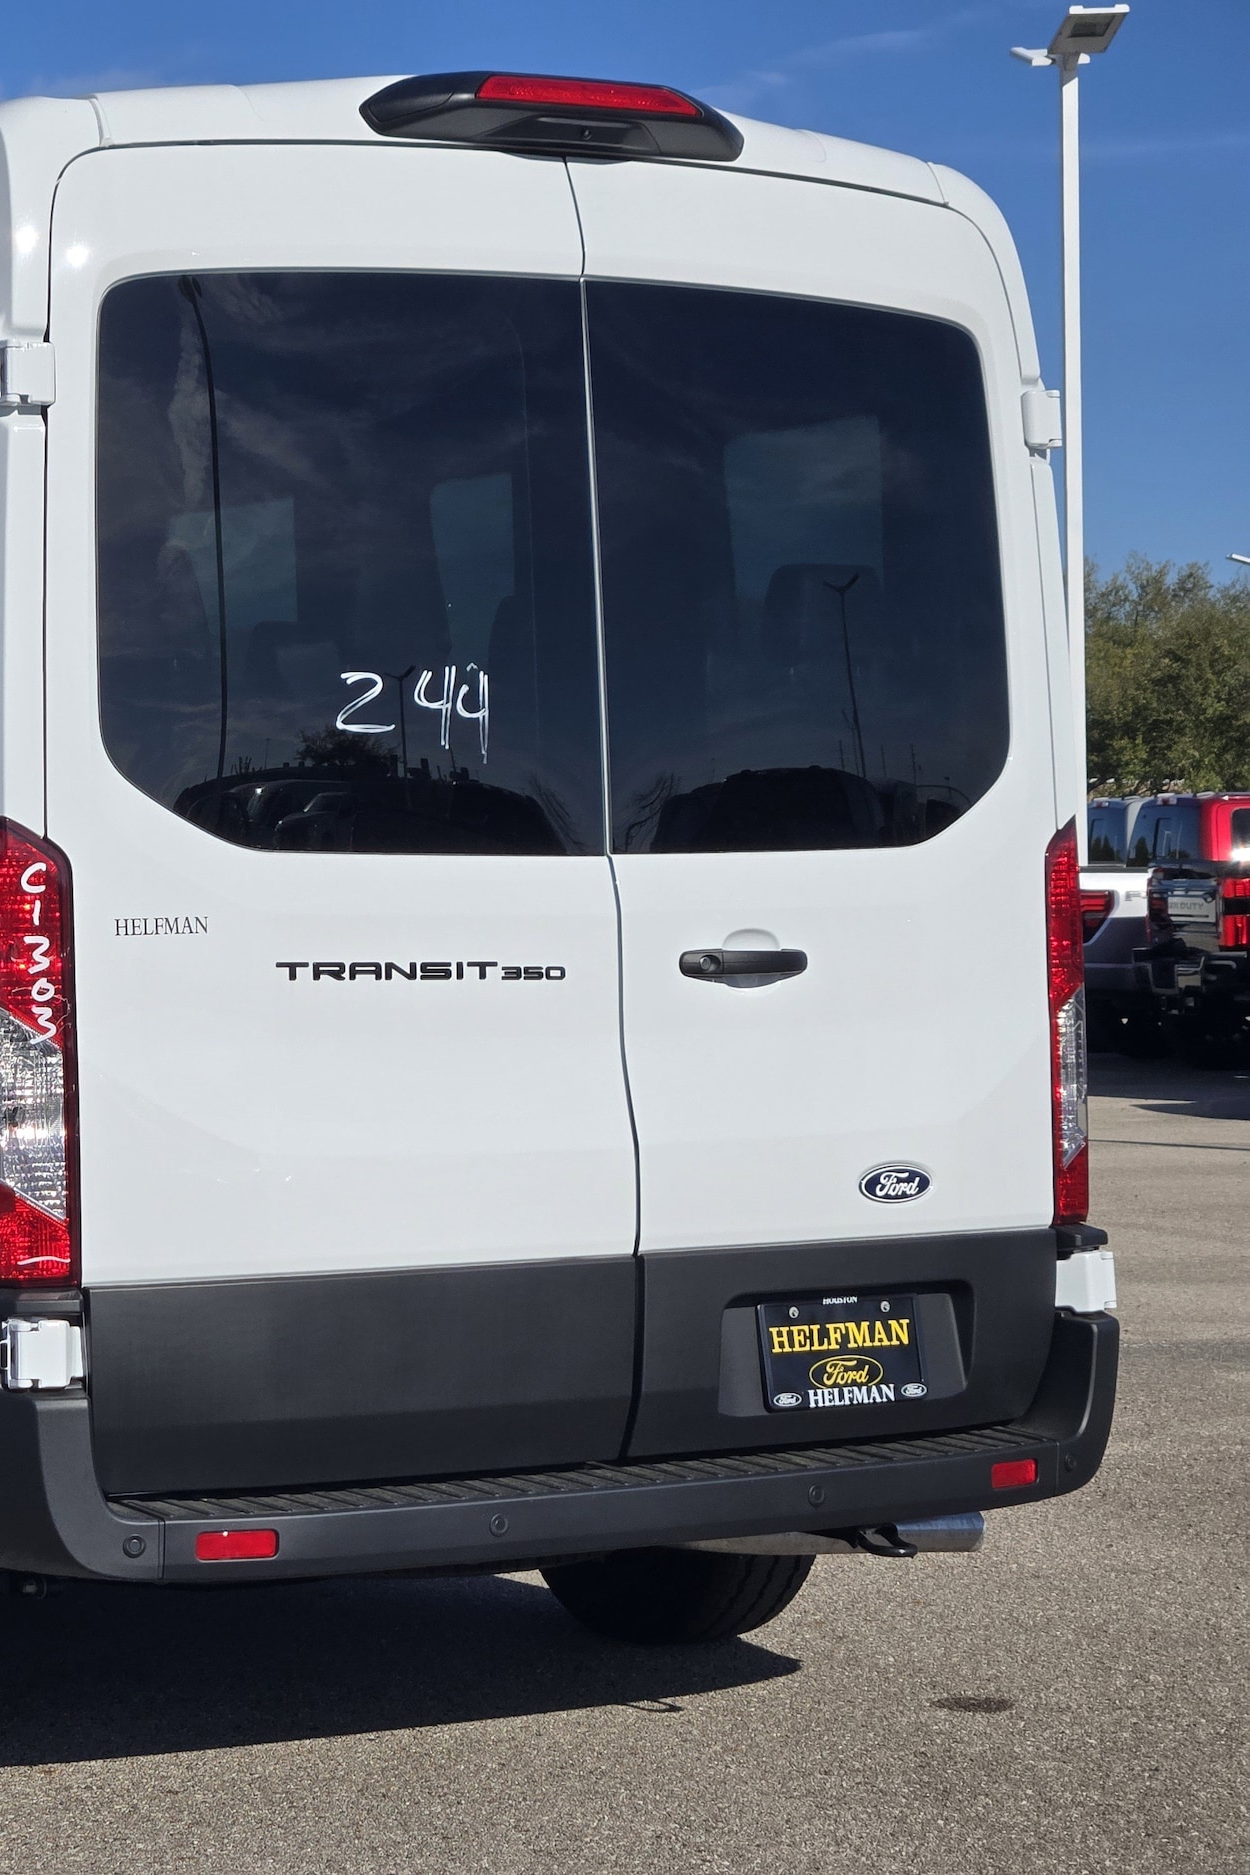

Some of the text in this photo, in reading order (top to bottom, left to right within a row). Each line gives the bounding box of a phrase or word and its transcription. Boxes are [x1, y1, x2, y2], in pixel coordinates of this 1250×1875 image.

[114, 916, 209, 936] HELFMAN
[275, 961, 566, 981] TRANSIT 350
[875, 1171, 921, 1197] Ford
[769, 1318, 910, 1354] HELFMAN
[823, 1359, 870, 1386] Ford
[807, 1384, 896, 1408] HELFMAN
